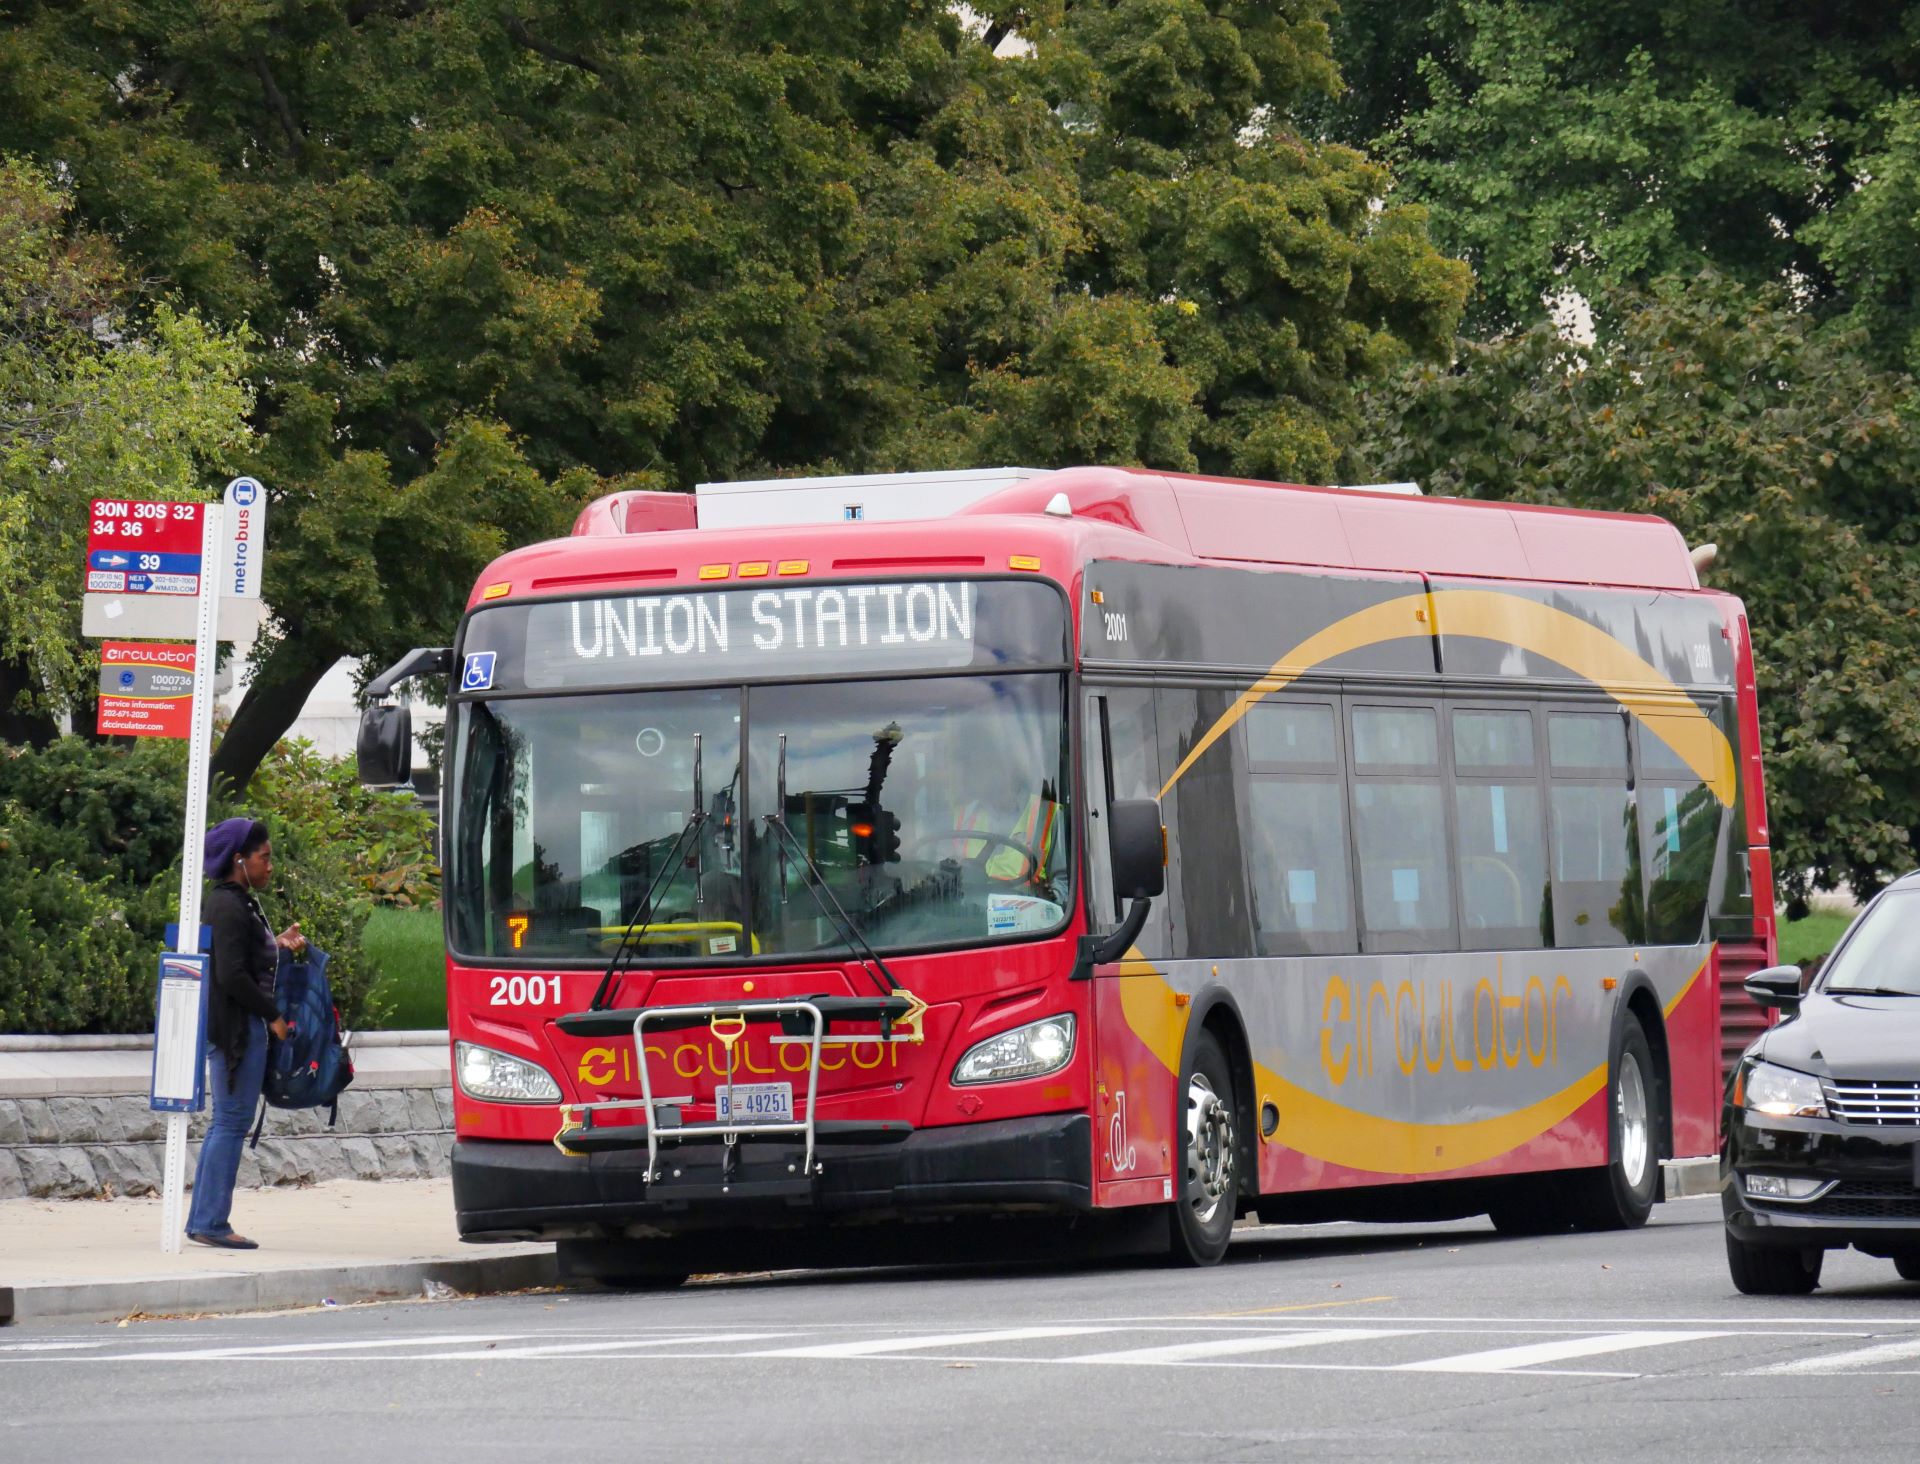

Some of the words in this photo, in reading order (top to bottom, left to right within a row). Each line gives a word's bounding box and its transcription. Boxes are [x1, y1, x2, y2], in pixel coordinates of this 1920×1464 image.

[94, 501, 128, 517] 30N
[133, 503, 167, 519] 30S
[172, 504, 195, 520] 32
[93, 519, 115, 535] 34
[120, 521, 143, 537] 36
[234, 509, 249, 593] metrobus
[139, 554, 161, 570] 39
[90, 580, 123, 589] 1000736
[128, 574, 146, 582] NEXT
[154, 585, 196, 593] WMATA.COM
[571, 594, 729, 659] UNION
[751, 581, 972, 651] STATION
[1104, 612, 1128, 641] 2001
[151, 674, 192, 686] 1000736
[103, 699, 131, 708] Service
[131, 700, 176, 710] information:
[103, 709, 149, 719] 202-671-2020
[102, 720, 164, 731] dccirculator.com
[509, 918, 528, 948] 7
[489, 975, 561, 1006] 2001
[721, 1096, 729, 1115] B
[746, 1093, 788, 1113] 49251
